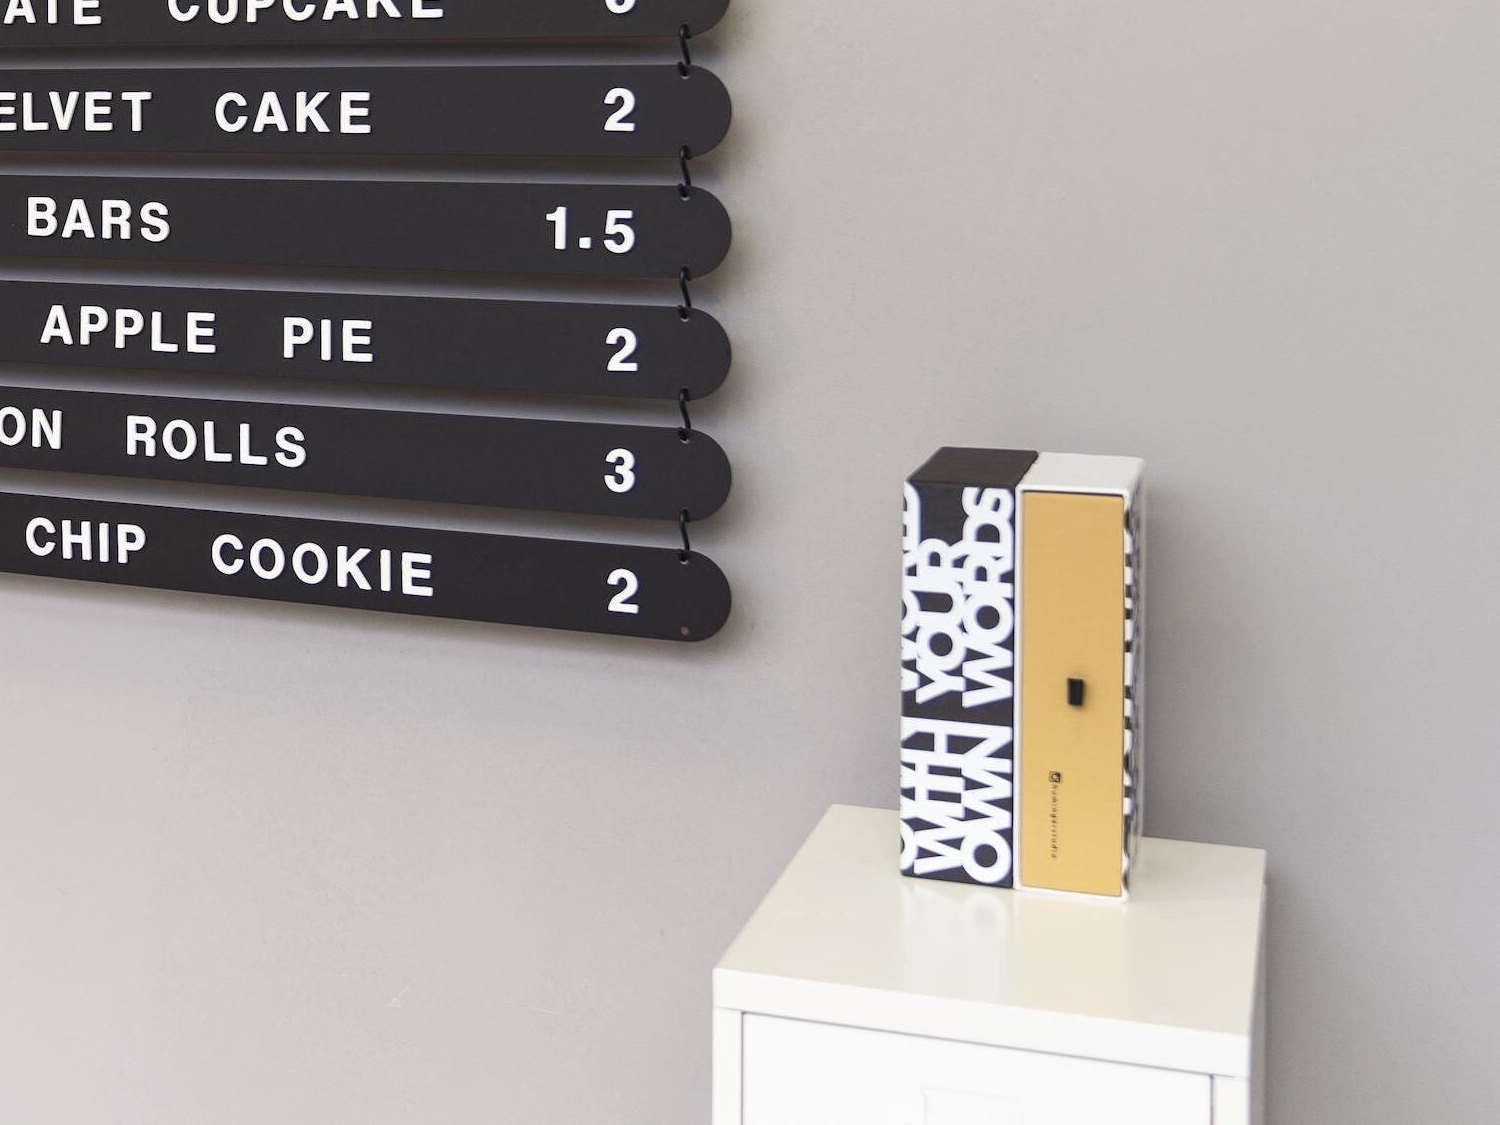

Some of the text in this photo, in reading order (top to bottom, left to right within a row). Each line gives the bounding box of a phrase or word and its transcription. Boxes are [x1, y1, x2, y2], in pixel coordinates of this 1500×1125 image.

[214, 91, 372, 134] CAKE
[603, 87, 636, 132] 2
[26, 196, 171, 243] BARS
[545, 206, 636, 254] 1.5
[40, 304, 217, 354] APPLE
[282, 316, 374, 363] PIE
[604, 327, 639, 373] 2
[126, 415, 307, 468] ROLLS
[603, 448, 636, 494] 3
[25, 516, 147, 564] CHIP
[210, 532, 435, 597] COOKIE
[606, 568, 640, 615] 2
[913, 538, 967, 875] WITH YOUR
[959, 486, 1014, 884] OWN WORDS
